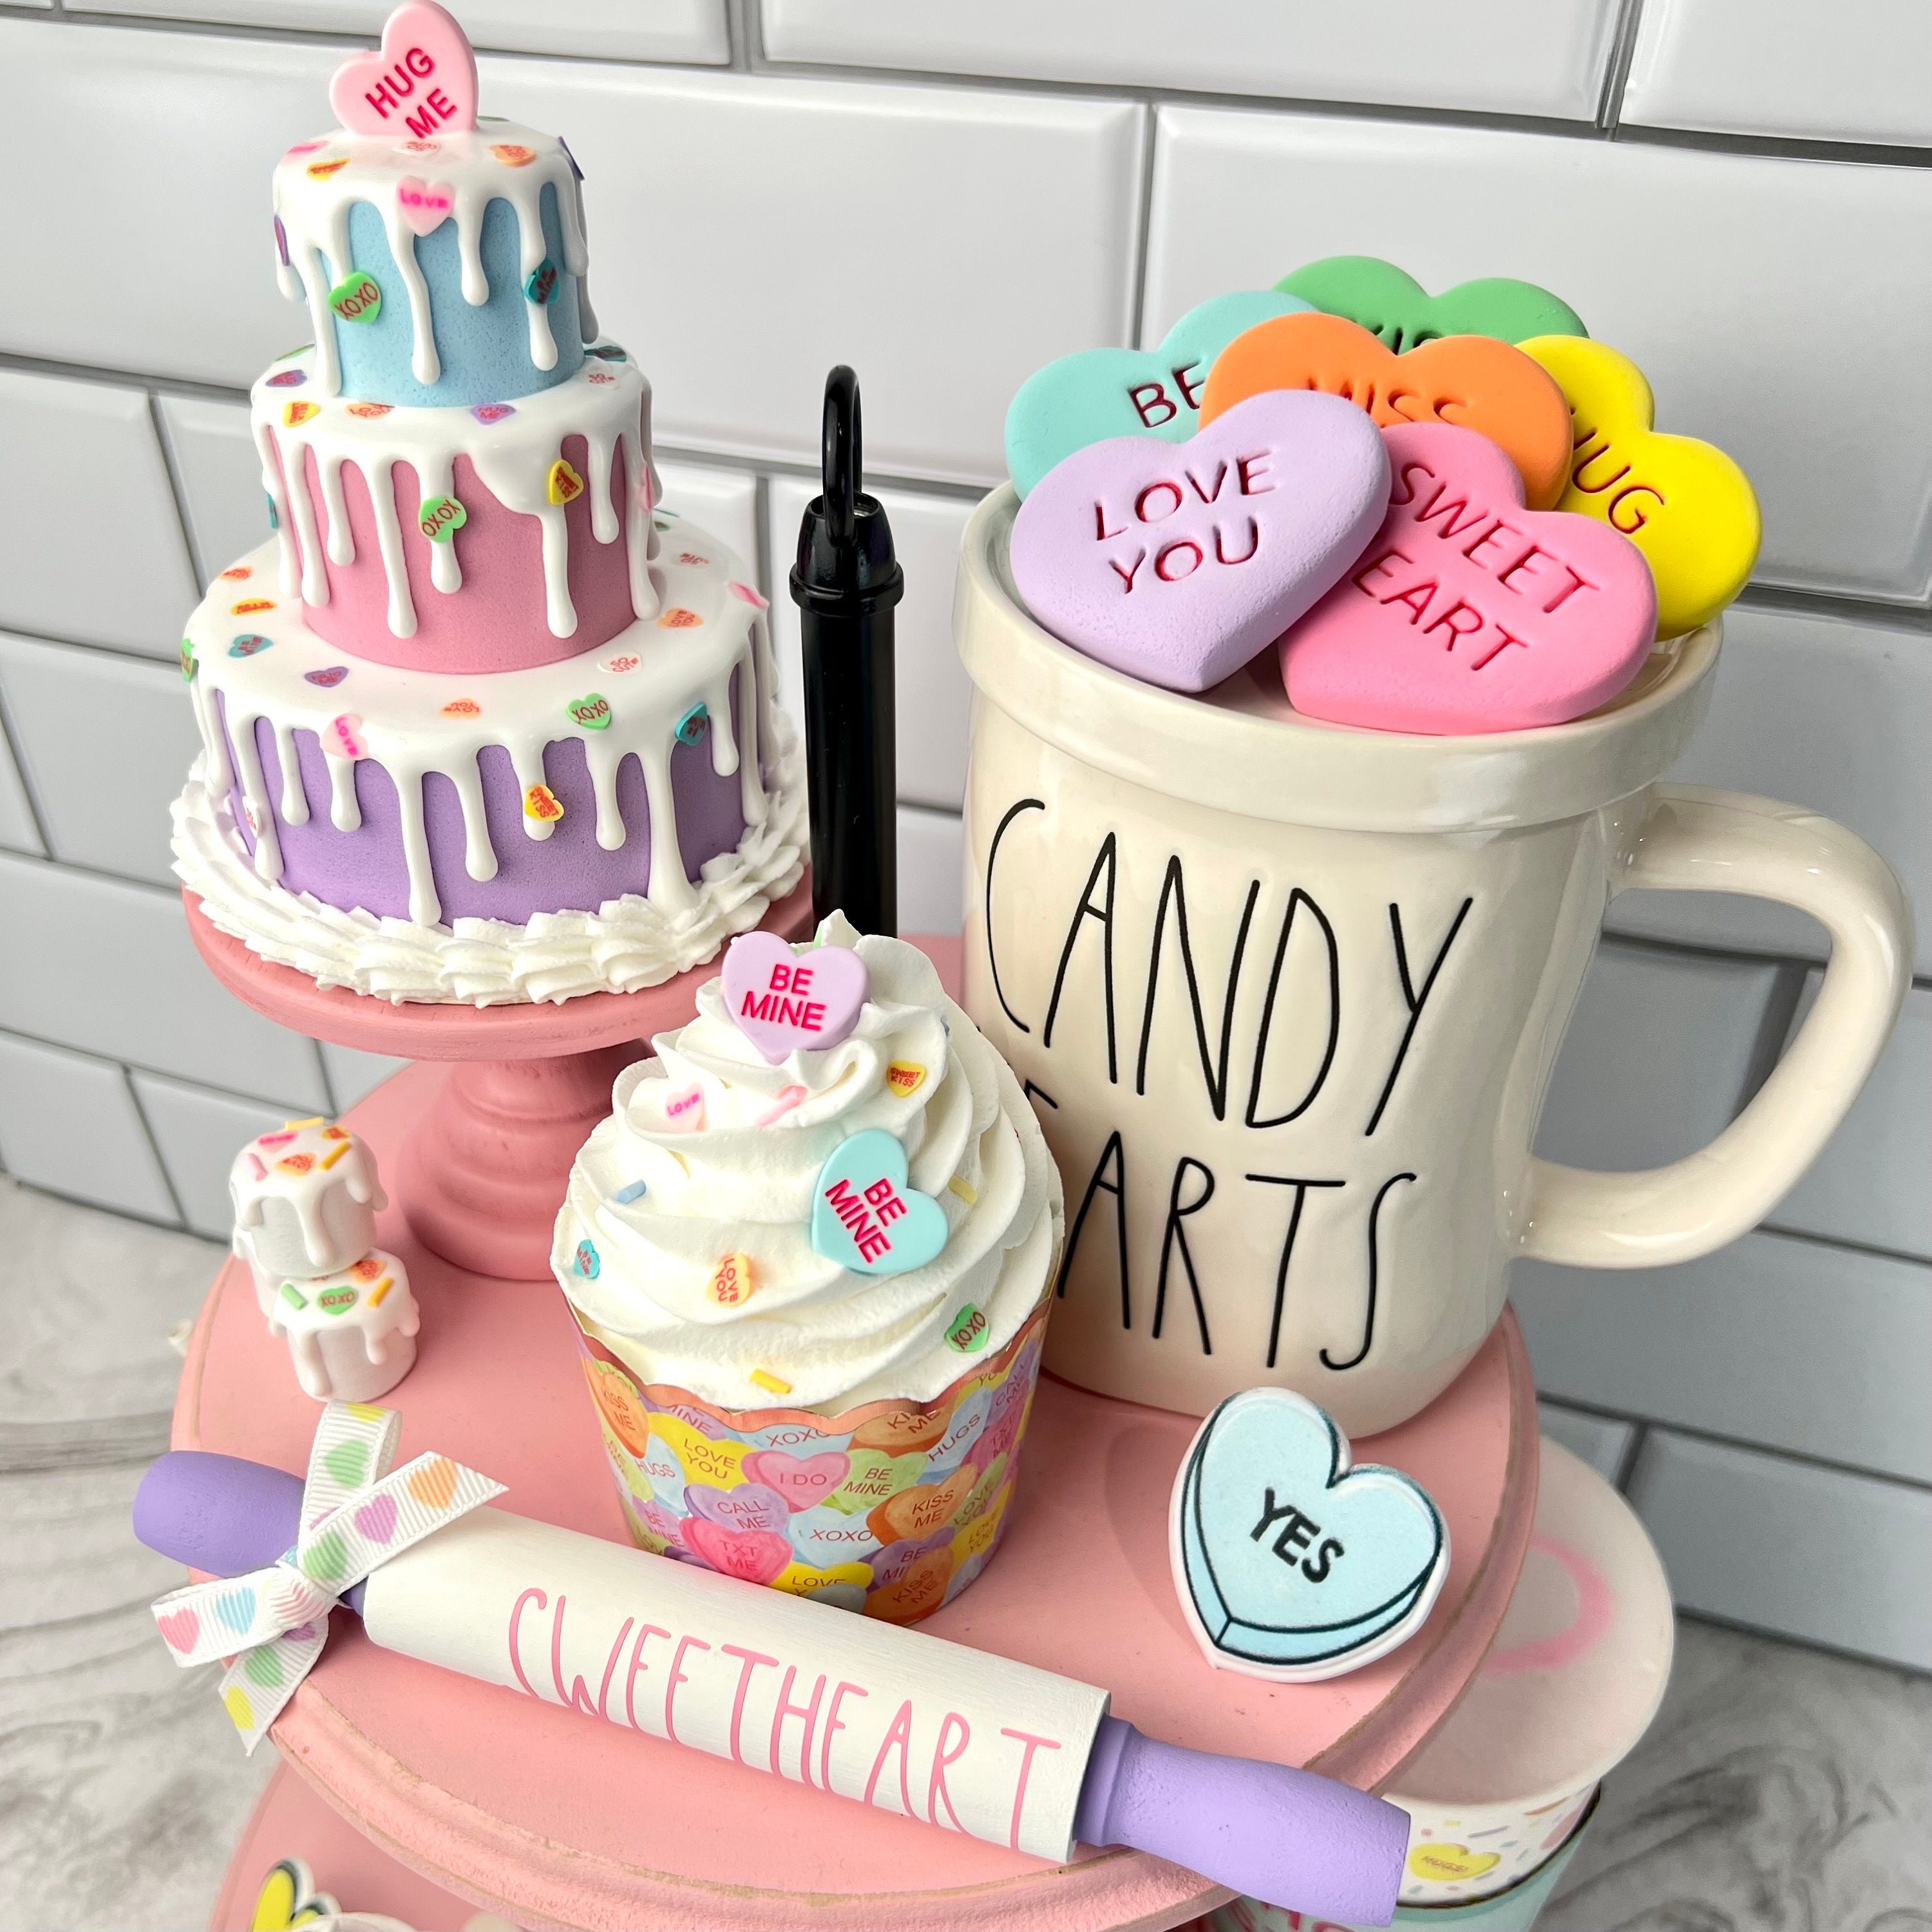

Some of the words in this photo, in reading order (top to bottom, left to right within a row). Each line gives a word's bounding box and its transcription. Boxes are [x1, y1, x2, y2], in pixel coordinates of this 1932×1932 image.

[365, 48, 435, 119] HUG
[406, 88, 458, 139] ME
[335, 281, 378, 320] XOXO
[1127, 360, 1206, 429] BE
[1307, 375, 1468, 426] ISS
[1092, 449, 1278, 543] LOVE
[1388, 462, 1602, 614] SWEET
[1108, 515, 1260, 596] YOU
[1351, 549, 1530, 672] EART
[611, 657, 629, 667] SO
[572, 699, 609, 724] XOXO
[529, 792, 551, 819] KISS
[770, 963, 814, 996] BE
[986, 797, 1474, 1136] CANDY
[741, 990, 827, 1032] MINE
[890, 1067, 921, 1079] SWEET
[891, 1074, 915, 1087] KISS
[864, 1178, 907, 1227] BE
[825, 1179, 892, 1264] MINE
[1024, 1078, 1417, 1371] ARTS
[715, 1269, 727, 1302] YOU
[724, 1258, 738, 1303] LOVE
[321, 1291, 355, 1307] XOXO
[952, 1311, 985, 1350] XOXO
[684, 1438, 736, 1470] LOVE
[929, 1414, 980, 1462] HUGS
[634, 1459, 676, 1478] HUGS
[687, 1452, 728, 1479] YOU
[780, 1473, 784, 1484] I
[793, 1473, 827, 1485] DO
[864, 1468, 893, 1481] BE
[843, 1481, 893, 1495] MINE
[912, 1490, 954, 1515] KISS
[645, 1510, 665, 1528] BE
[717, 1500, 770, 1514] CALL
[736, 1516, 771, 1529] ME
[914, 1508, 944, 1529] ME
[719, 1539, 758, 1557] TXT
[810, 1529, 874, 1542] XOXO
[1249, 1486, 1345, 1584] YES
[726, 1555, 758, 1571] ME
[900, 1546, 929, 1563] BE
[882, 1566, 905, 1580] MI
[893, 1569, 933, 1604] KISS
